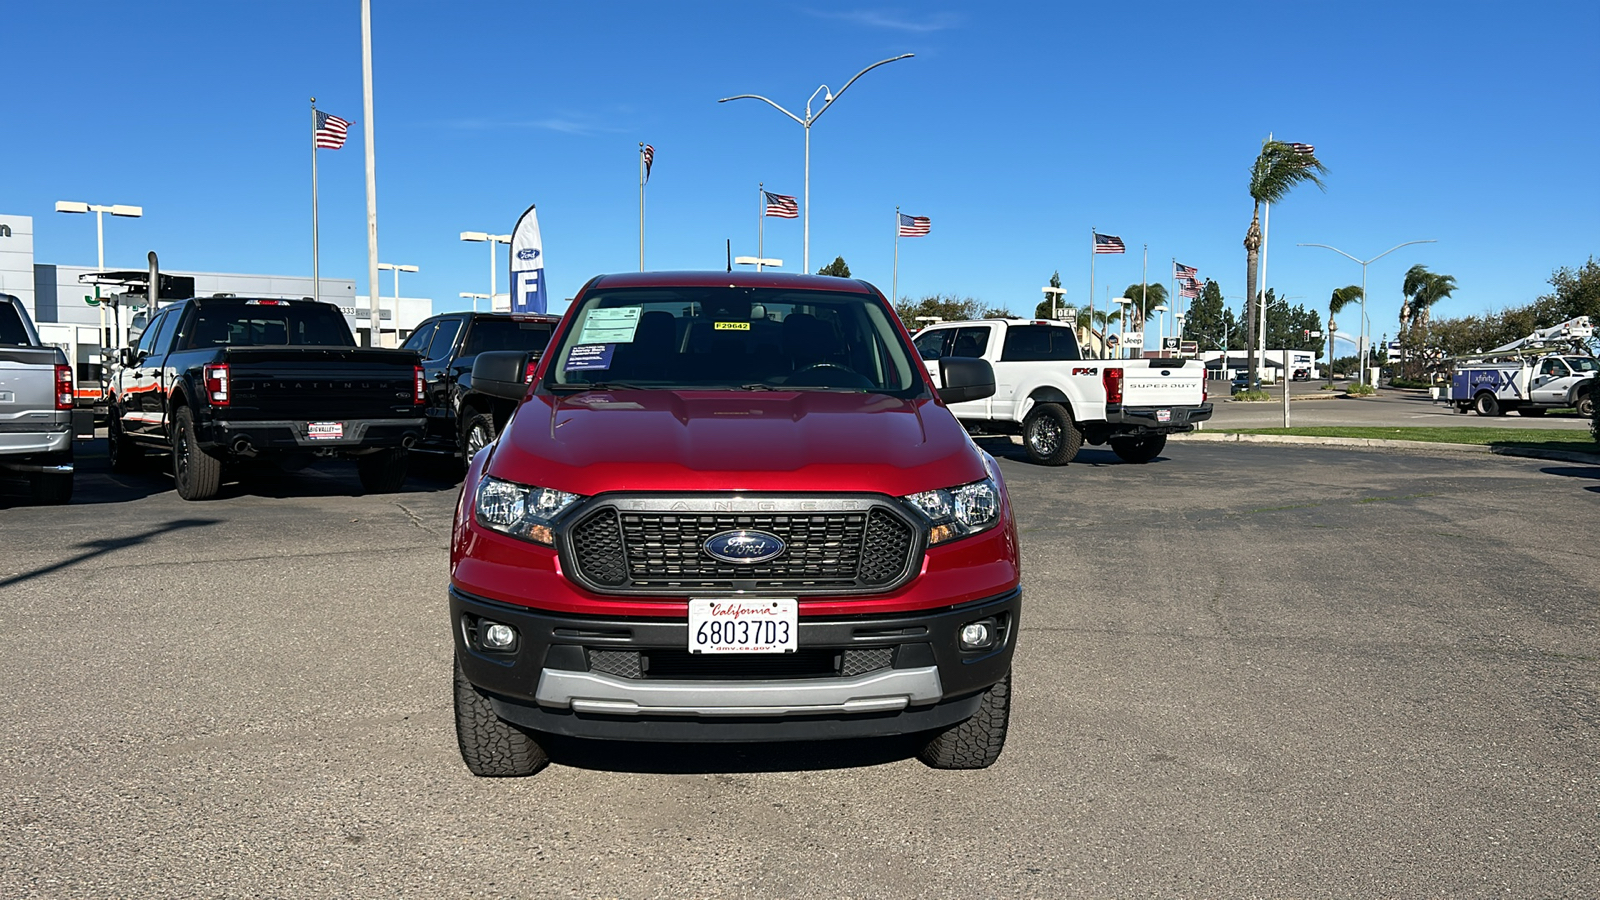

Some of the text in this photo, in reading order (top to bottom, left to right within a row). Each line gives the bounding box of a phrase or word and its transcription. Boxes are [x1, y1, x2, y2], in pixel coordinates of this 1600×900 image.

[520, 249, 536, 260] Ford
[517, 271, 538, 305] F
[1057, 309, 1076, 317] OEM
[1072, 367, 1098, 376] FX4
[628, 499, 860, 511] RANGER
[723, 536, 766, 555] Ford
[712, 603, 777, 619] California
[696, 620, 789, 645] 68037D3
